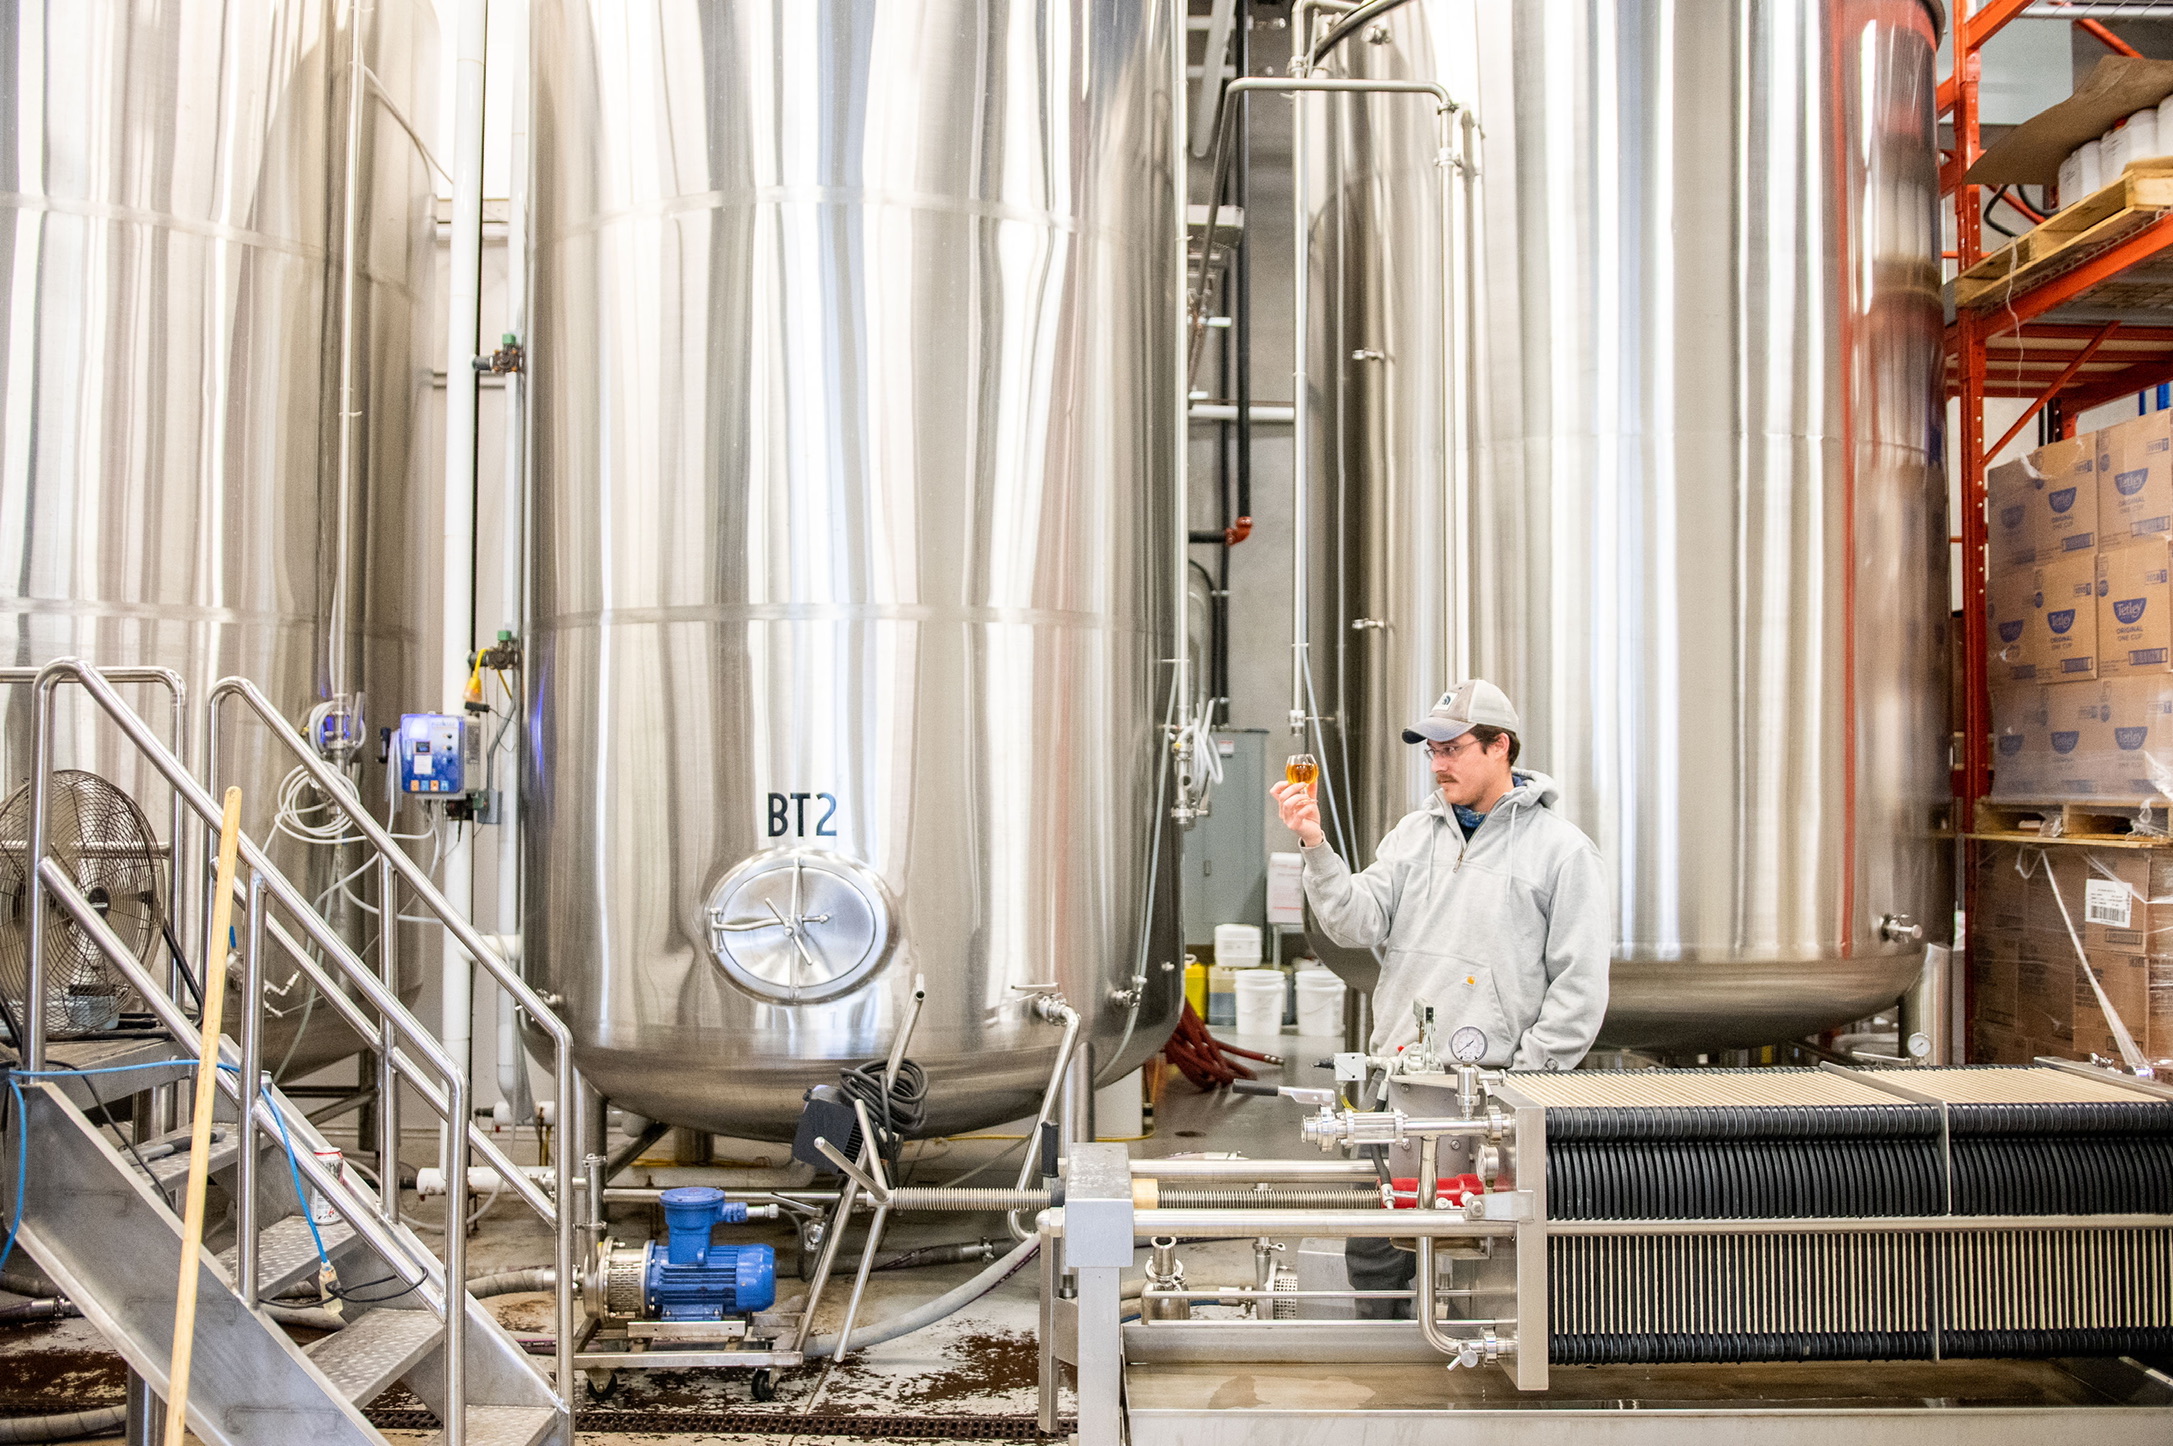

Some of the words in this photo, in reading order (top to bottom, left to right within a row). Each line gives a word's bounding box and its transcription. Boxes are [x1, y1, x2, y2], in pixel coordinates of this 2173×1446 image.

[2117, 601, 2143, 618] Tetley
[2051, 612, 2073, 628] Tetley
[2117, 626, 2143, 635] ORIGINAL
[767, 792, 837, 837] BT2
